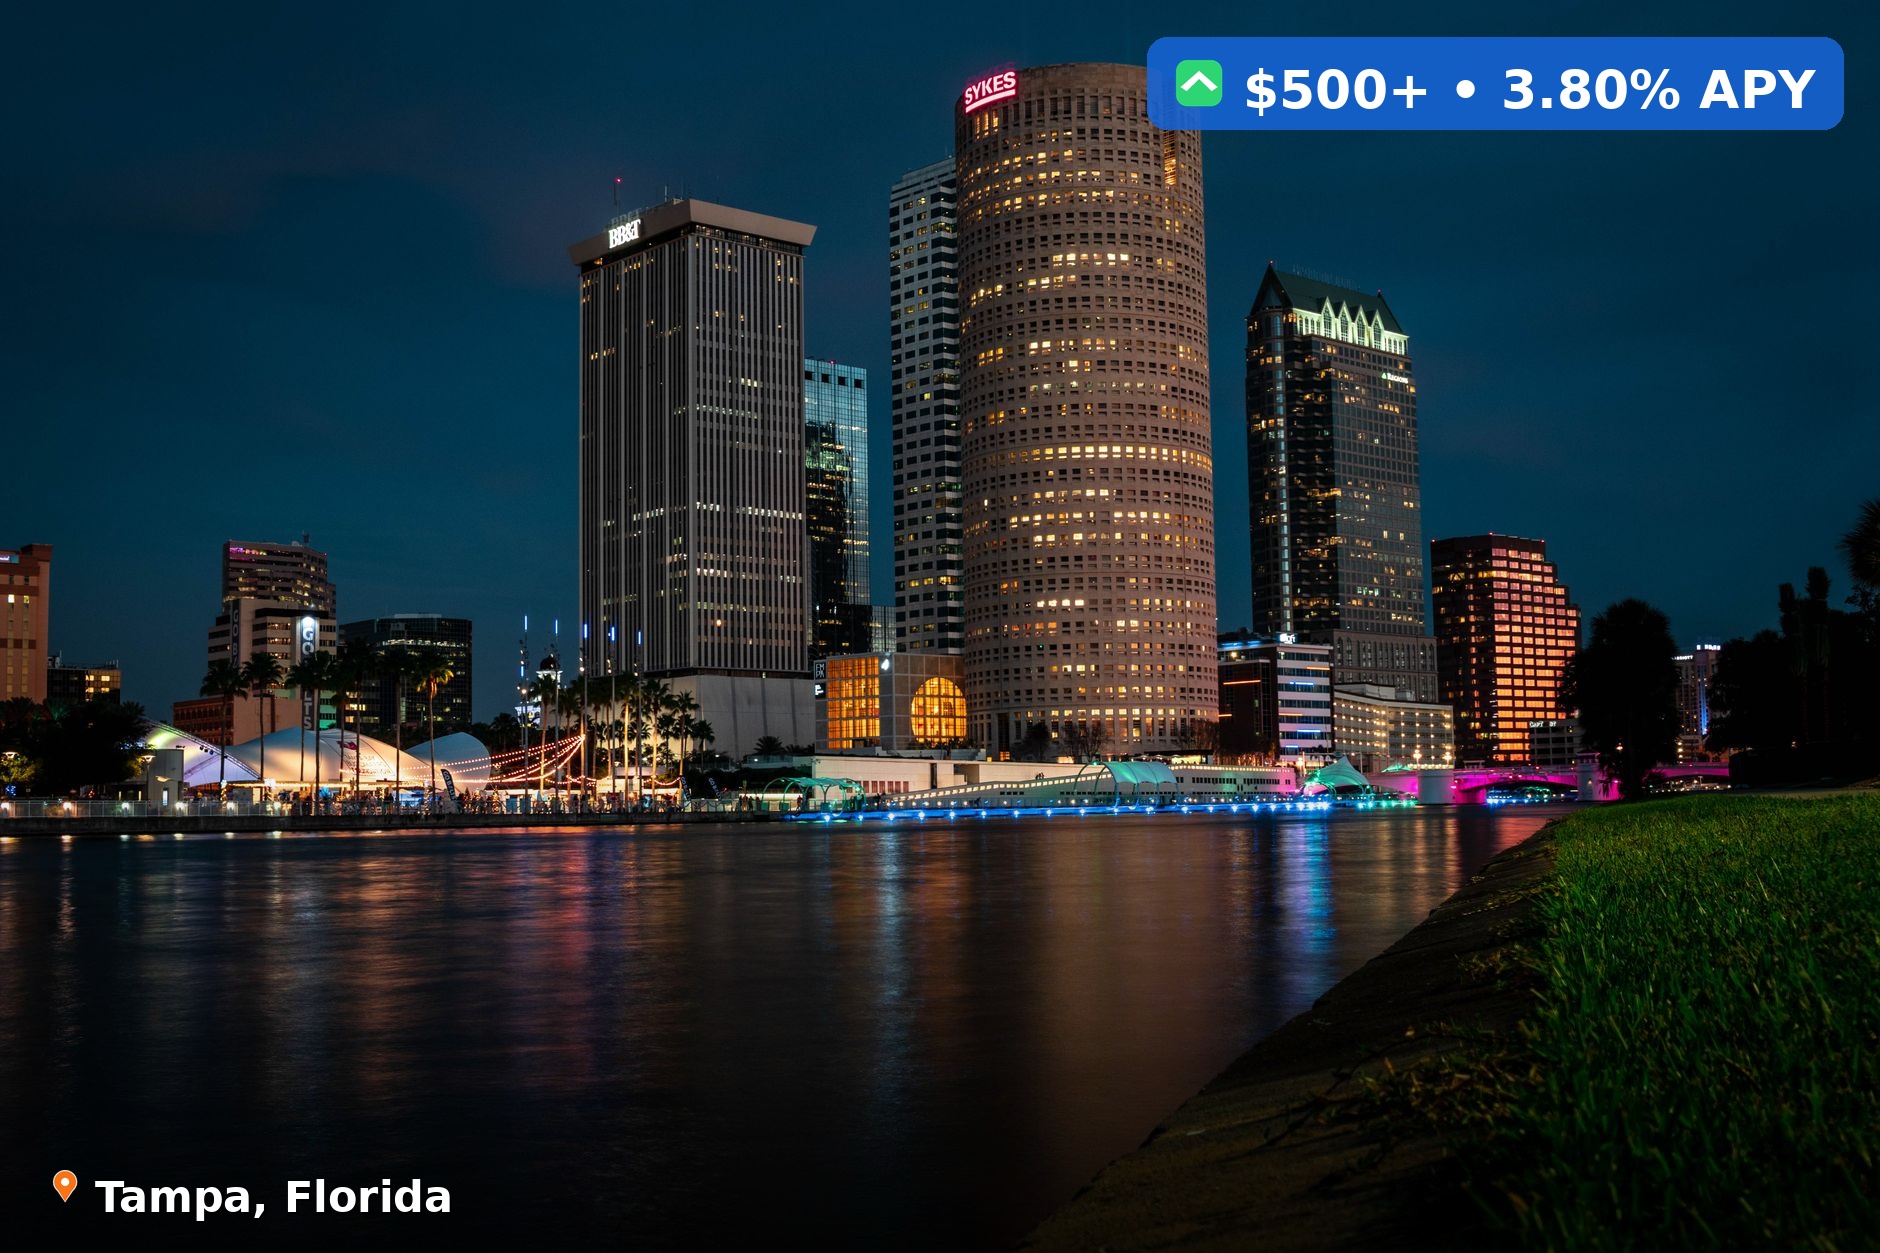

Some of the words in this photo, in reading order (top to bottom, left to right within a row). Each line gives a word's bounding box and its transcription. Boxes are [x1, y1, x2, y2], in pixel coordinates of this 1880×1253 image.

[964, 71, 1017, 105] SYKES
[608, 218, 641, 249] BB&T
[302, 628, 315, 655] GO
